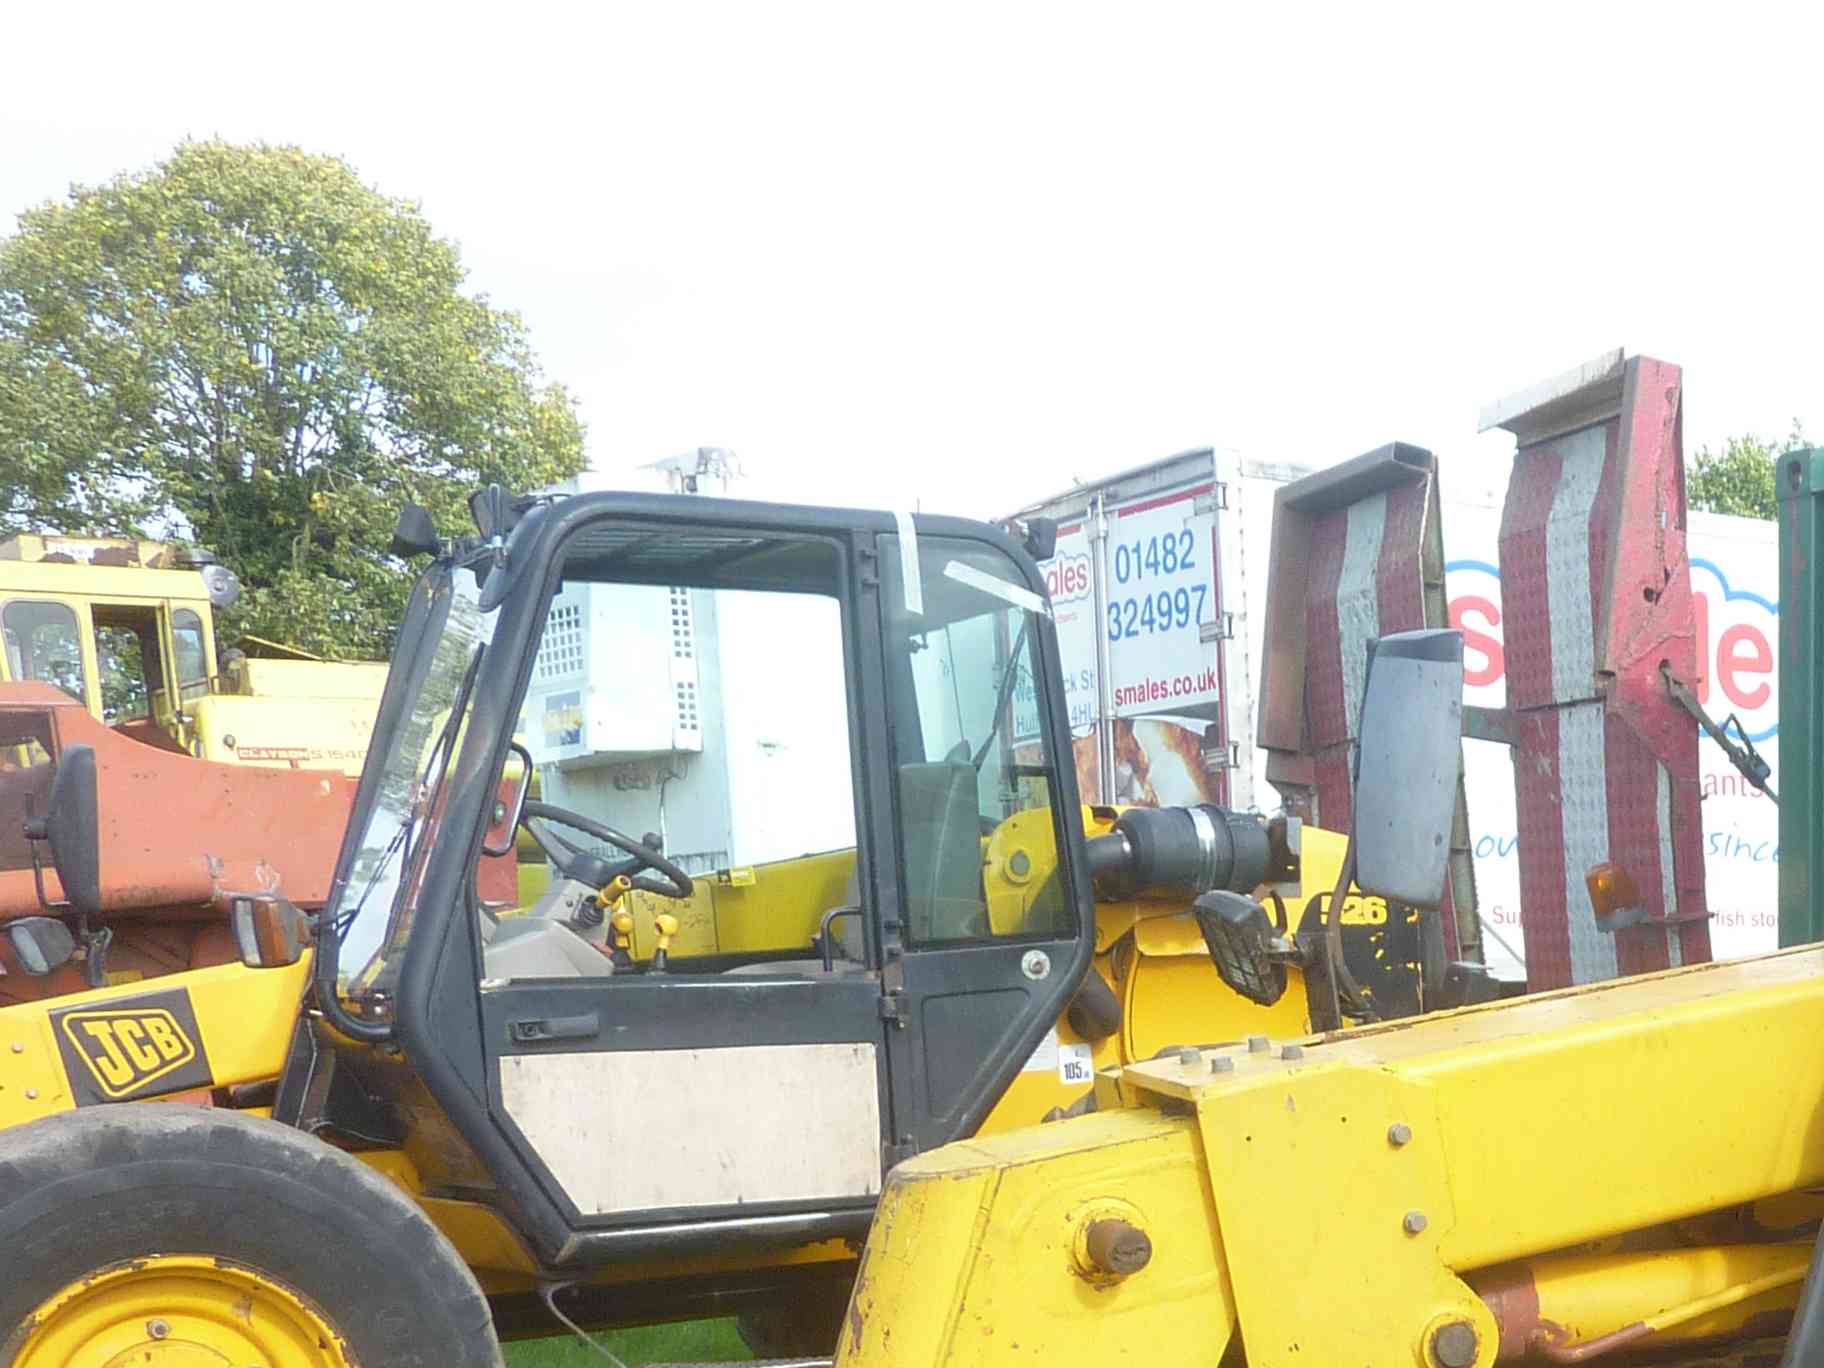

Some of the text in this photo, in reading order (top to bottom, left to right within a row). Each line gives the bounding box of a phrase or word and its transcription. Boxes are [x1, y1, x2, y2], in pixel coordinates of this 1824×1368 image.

[1115, 528, 1196, 585] 01482
[1107, 583, 1208, 642] 324997
[1115, 667, 1218, 708] smales.co.uk
[82, 1016, 185, 1086] JCB
